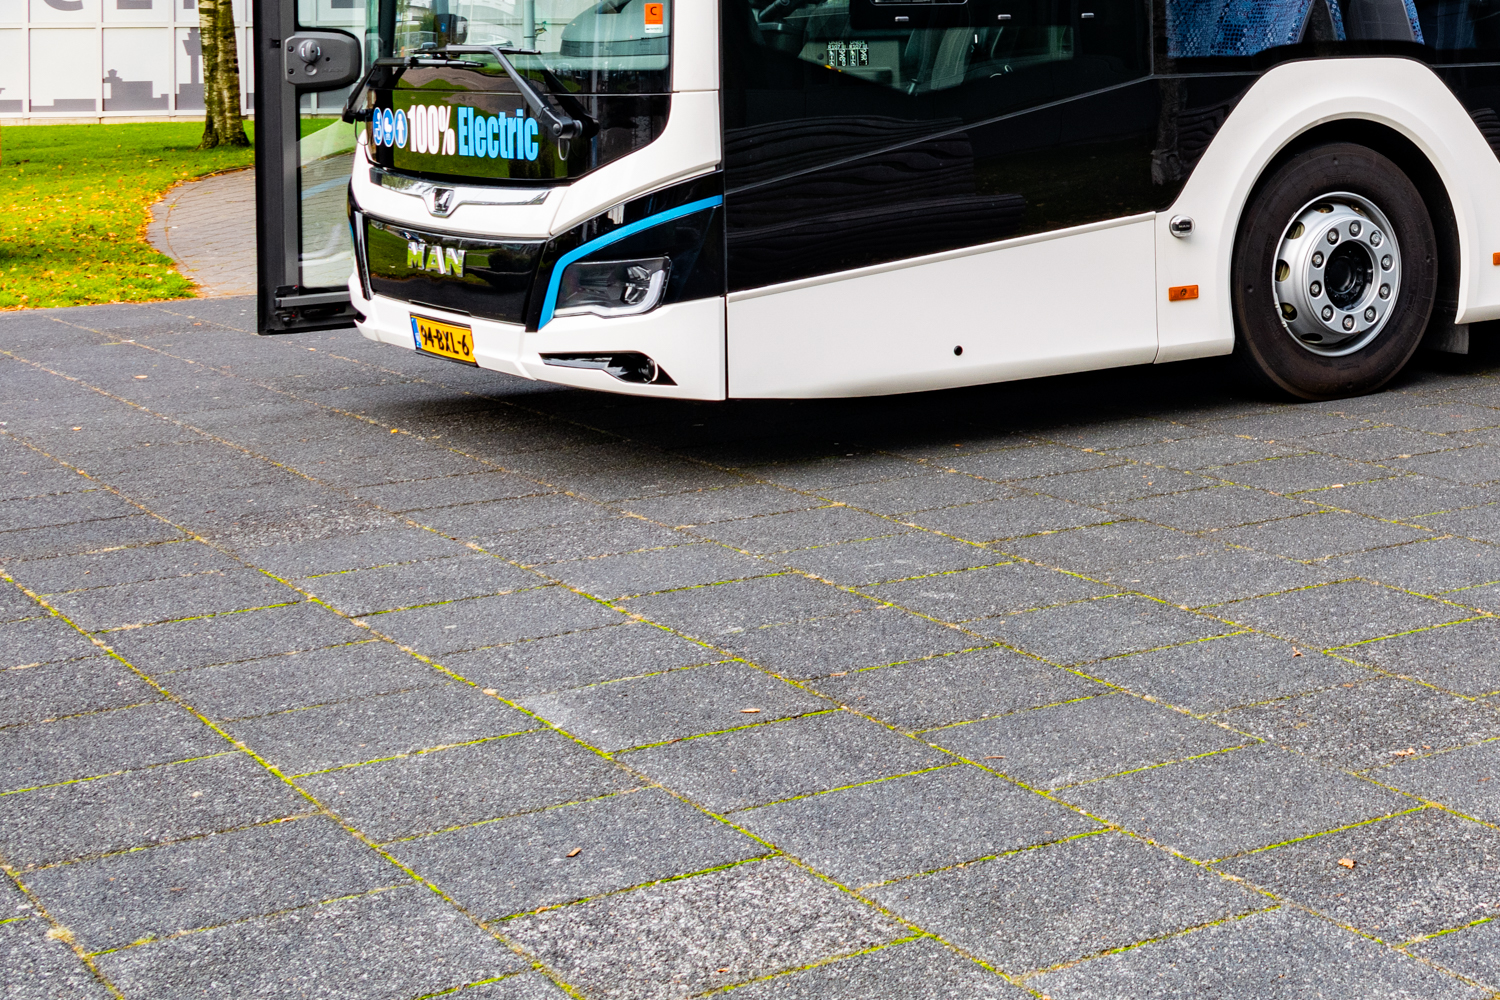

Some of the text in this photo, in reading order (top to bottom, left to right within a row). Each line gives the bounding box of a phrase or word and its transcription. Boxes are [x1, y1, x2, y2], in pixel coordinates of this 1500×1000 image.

[650, 6, 657, 16] C
[407, 104, 539, 162] 100% Electric
[407, 242, 467, 278] MAN
[420, 324, 470, 356] 94-BXL-6
